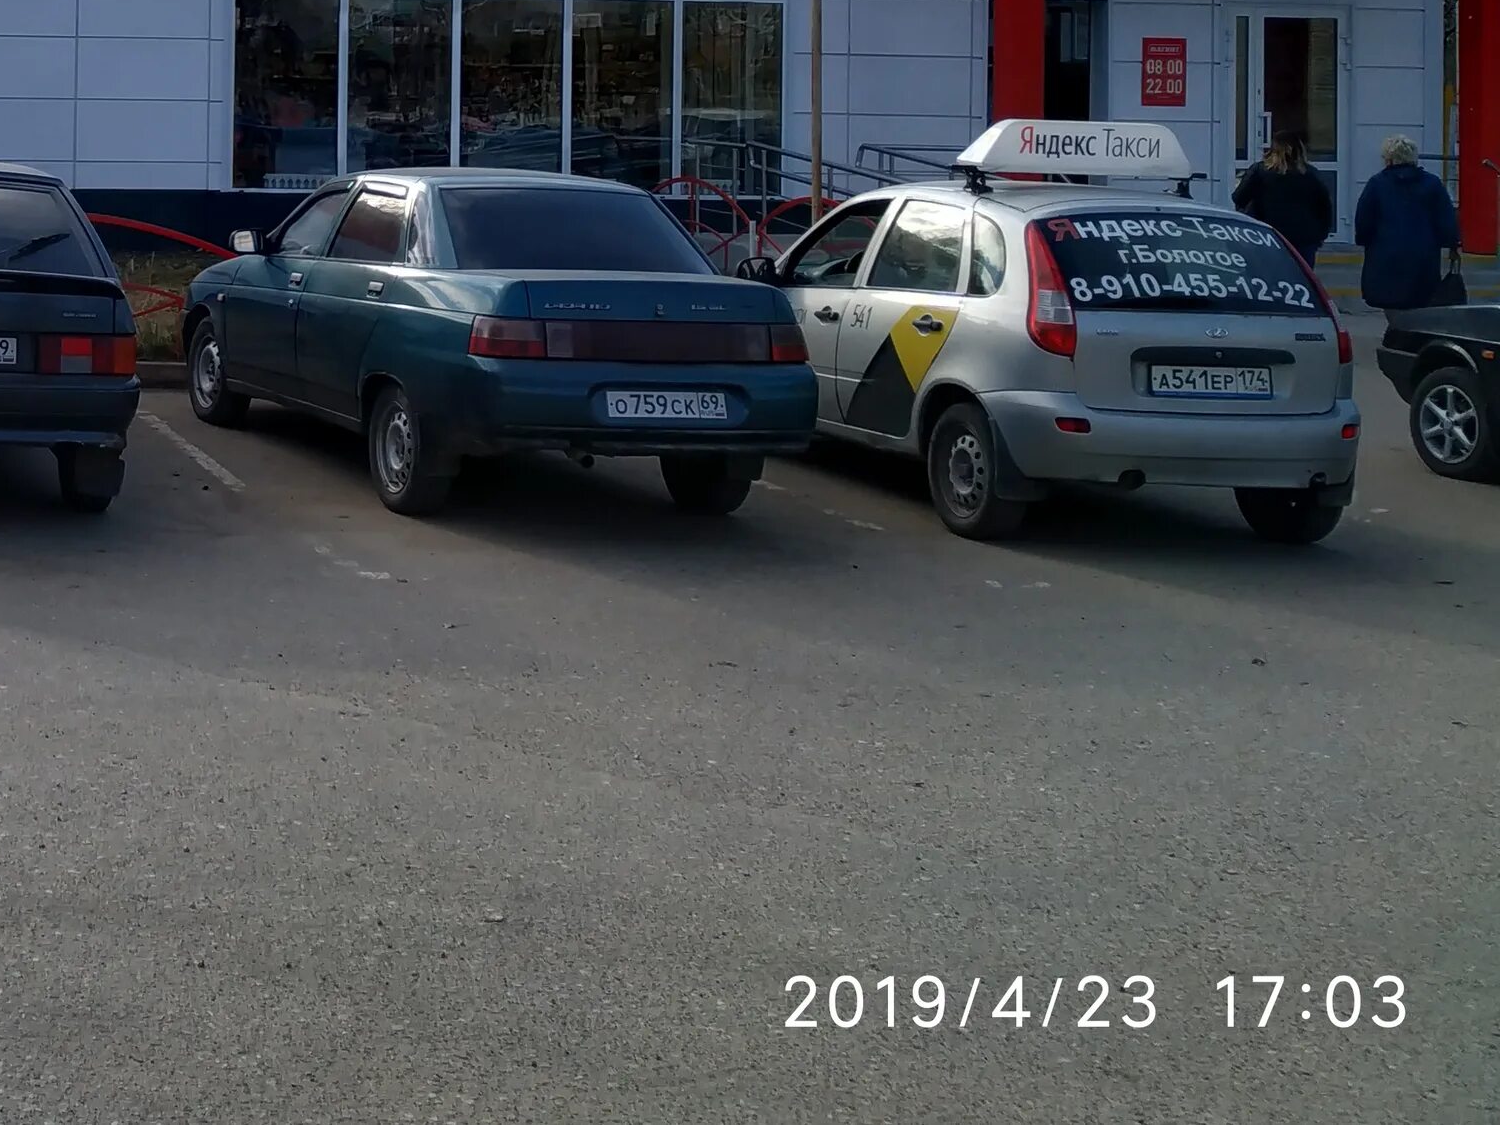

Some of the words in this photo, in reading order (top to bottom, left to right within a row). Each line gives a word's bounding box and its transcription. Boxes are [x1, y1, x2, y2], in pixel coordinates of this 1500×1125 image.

[1019, 126, 1097, 158] Яндекс
[1102, 128, 1160, 158] Такси
[1048, 219, 1183, 242] Яндекс
[1182, 216, 1281, 250] Такси
[1117, 244, 1247, 268] г.Бологое
[1069, 273, 1315, 309] 8-910-455-12-22
